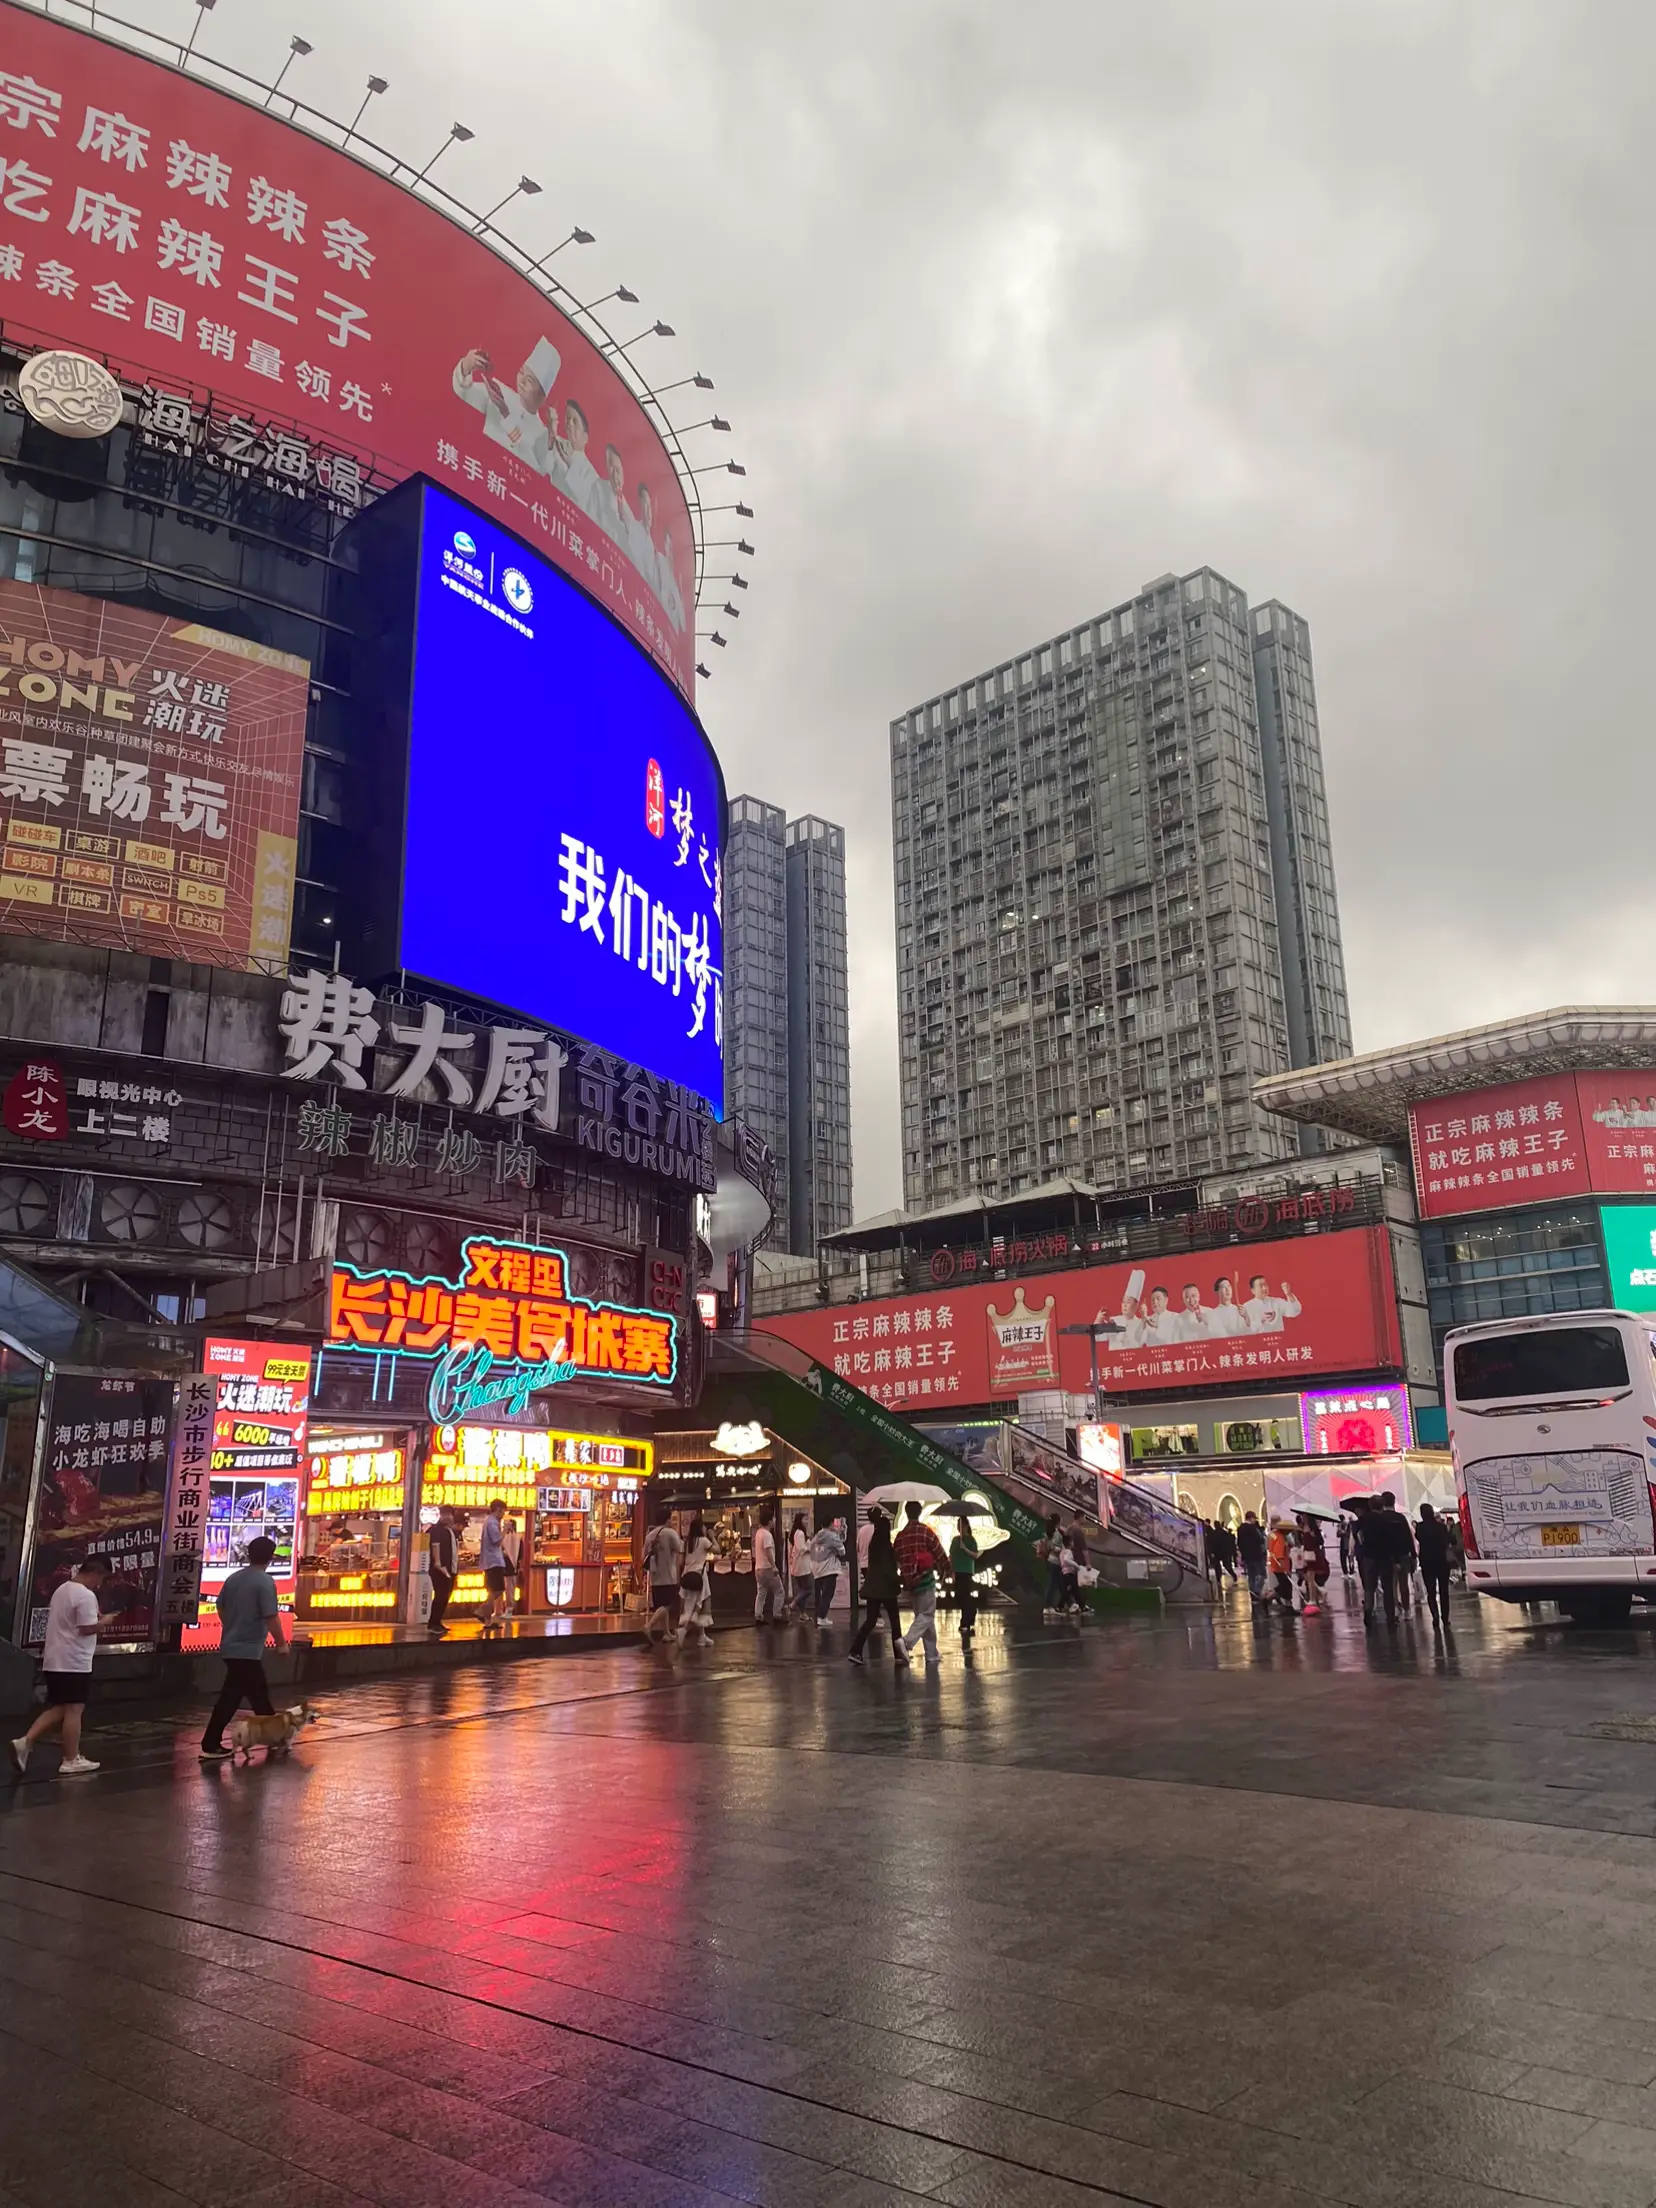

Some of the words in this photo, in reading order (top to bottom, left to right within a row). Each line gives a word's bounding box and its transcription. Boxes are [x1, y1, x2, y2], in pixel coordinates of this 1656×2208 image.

[0, 72, 376, 280] 宗麻辣辣条
[0, 156, 372, 348] 吃麻辣王子
[149, 668, 230, 707] 火迷
[142, 699, 229, 745] 潮玩
[0, 737, 229, 840] 票畅玩
[12, 825, 58, 843] 碰碰车
[76, 836, 111, 854] 桌游
[11, 852, 49, 872] 影院
[63, 861, 111, 882] 剧本杀
[133, 846, 167, 865] 酒吧
[188, 857, 220, 877] 射箭
[14, 882, 39, 898] VR
[69, 889, 102, 909] 棋牌
[126, 874, 170, 892] SWITCH
[128, 899, 162, 919] 密室
[277, 969, 569, 1132] 费大厨
[17, 1064, 59, 1134] 陈小龙
[76, 1077, 183, 1108] 眼视光中心
[76, 1108, 171, 1143] 上二楼
[1424, 1100, 1565, 1144] 正宗麻辣辣条
[296, 1097, 538, 1190] 辣椒炒肉
[577, 1113, 702, 1187] KIGURUMI
[1427, 1129, 1569, 1172] 就吃麻辣王子
[1428, 1157, 1576, 1194] 麻辣辣条全国销量领先
[1275, 1190, 1355, 1224] 海底捞
[959, 1234, 1068, 1273] 海底捞火锅
[466, 1245, 564, 1299] 文程里
[330, 1272, 672, 1376] 长沙美食城寨
[832, 1305, 954, 1343] 正宗麻辣辣条
[1001, 1326, 1044, 1344] 麻辣王子
[833, 1341, 956, 1376] 就吃麻辣王子
[101, 1380, 135, 1393] 龙虾节
[216, 1383, 294, 1413] 火迷潮玩
[426, 1337, 577, 1426] Changsha
[54, 1415, 166, 1446] 海吃海喝自助
[52, 1440, 165, 1471] 小龙虾狂欢季
[169, 1382, 211, 1595] 长沙市步行商业街商会
